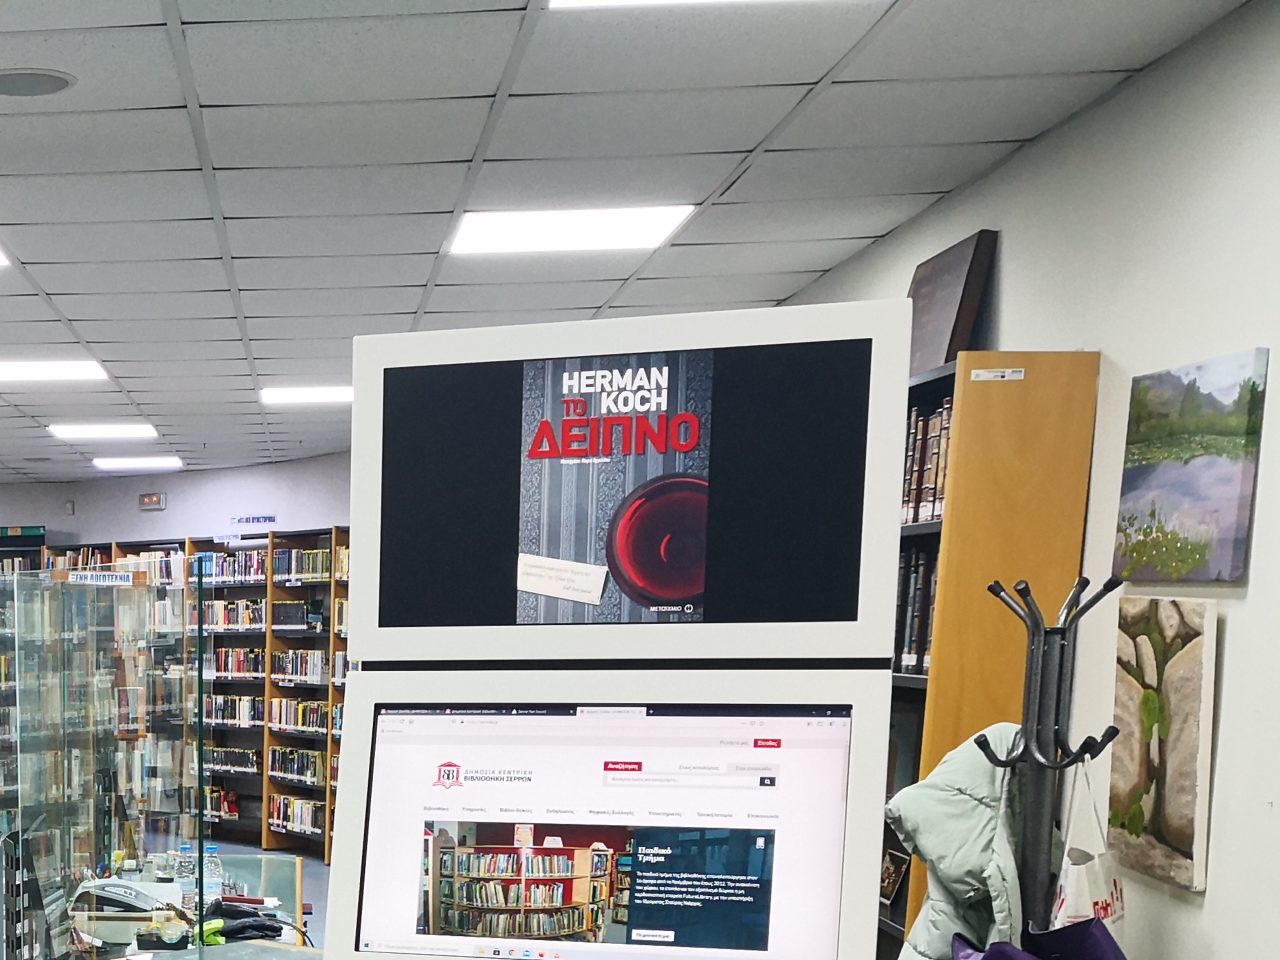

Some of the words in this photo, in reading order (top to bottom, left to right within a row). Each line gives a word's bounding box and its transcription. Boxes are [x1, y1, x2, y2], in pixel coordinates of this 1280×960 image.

[562, 366, 669, 394] HERMAN
[561, 397, 587, 417] ΤΟ
[600, 388, 668, 413] KOCH
[527, 411, 701, 459] ΔΕΙΠΝΟ
[71, 574, 89, 583] ΞΕΝΗ
[90, 574, 130, 583] ΛΟΓΟΤΕΧΝΙΑ
[463, 775, 504, 783] ΒΙΒΛΙΟΘΗΚΗ
[637, 846, 672, 855] Παιδικό
[637, 854, 665, 862] Τμήμα
